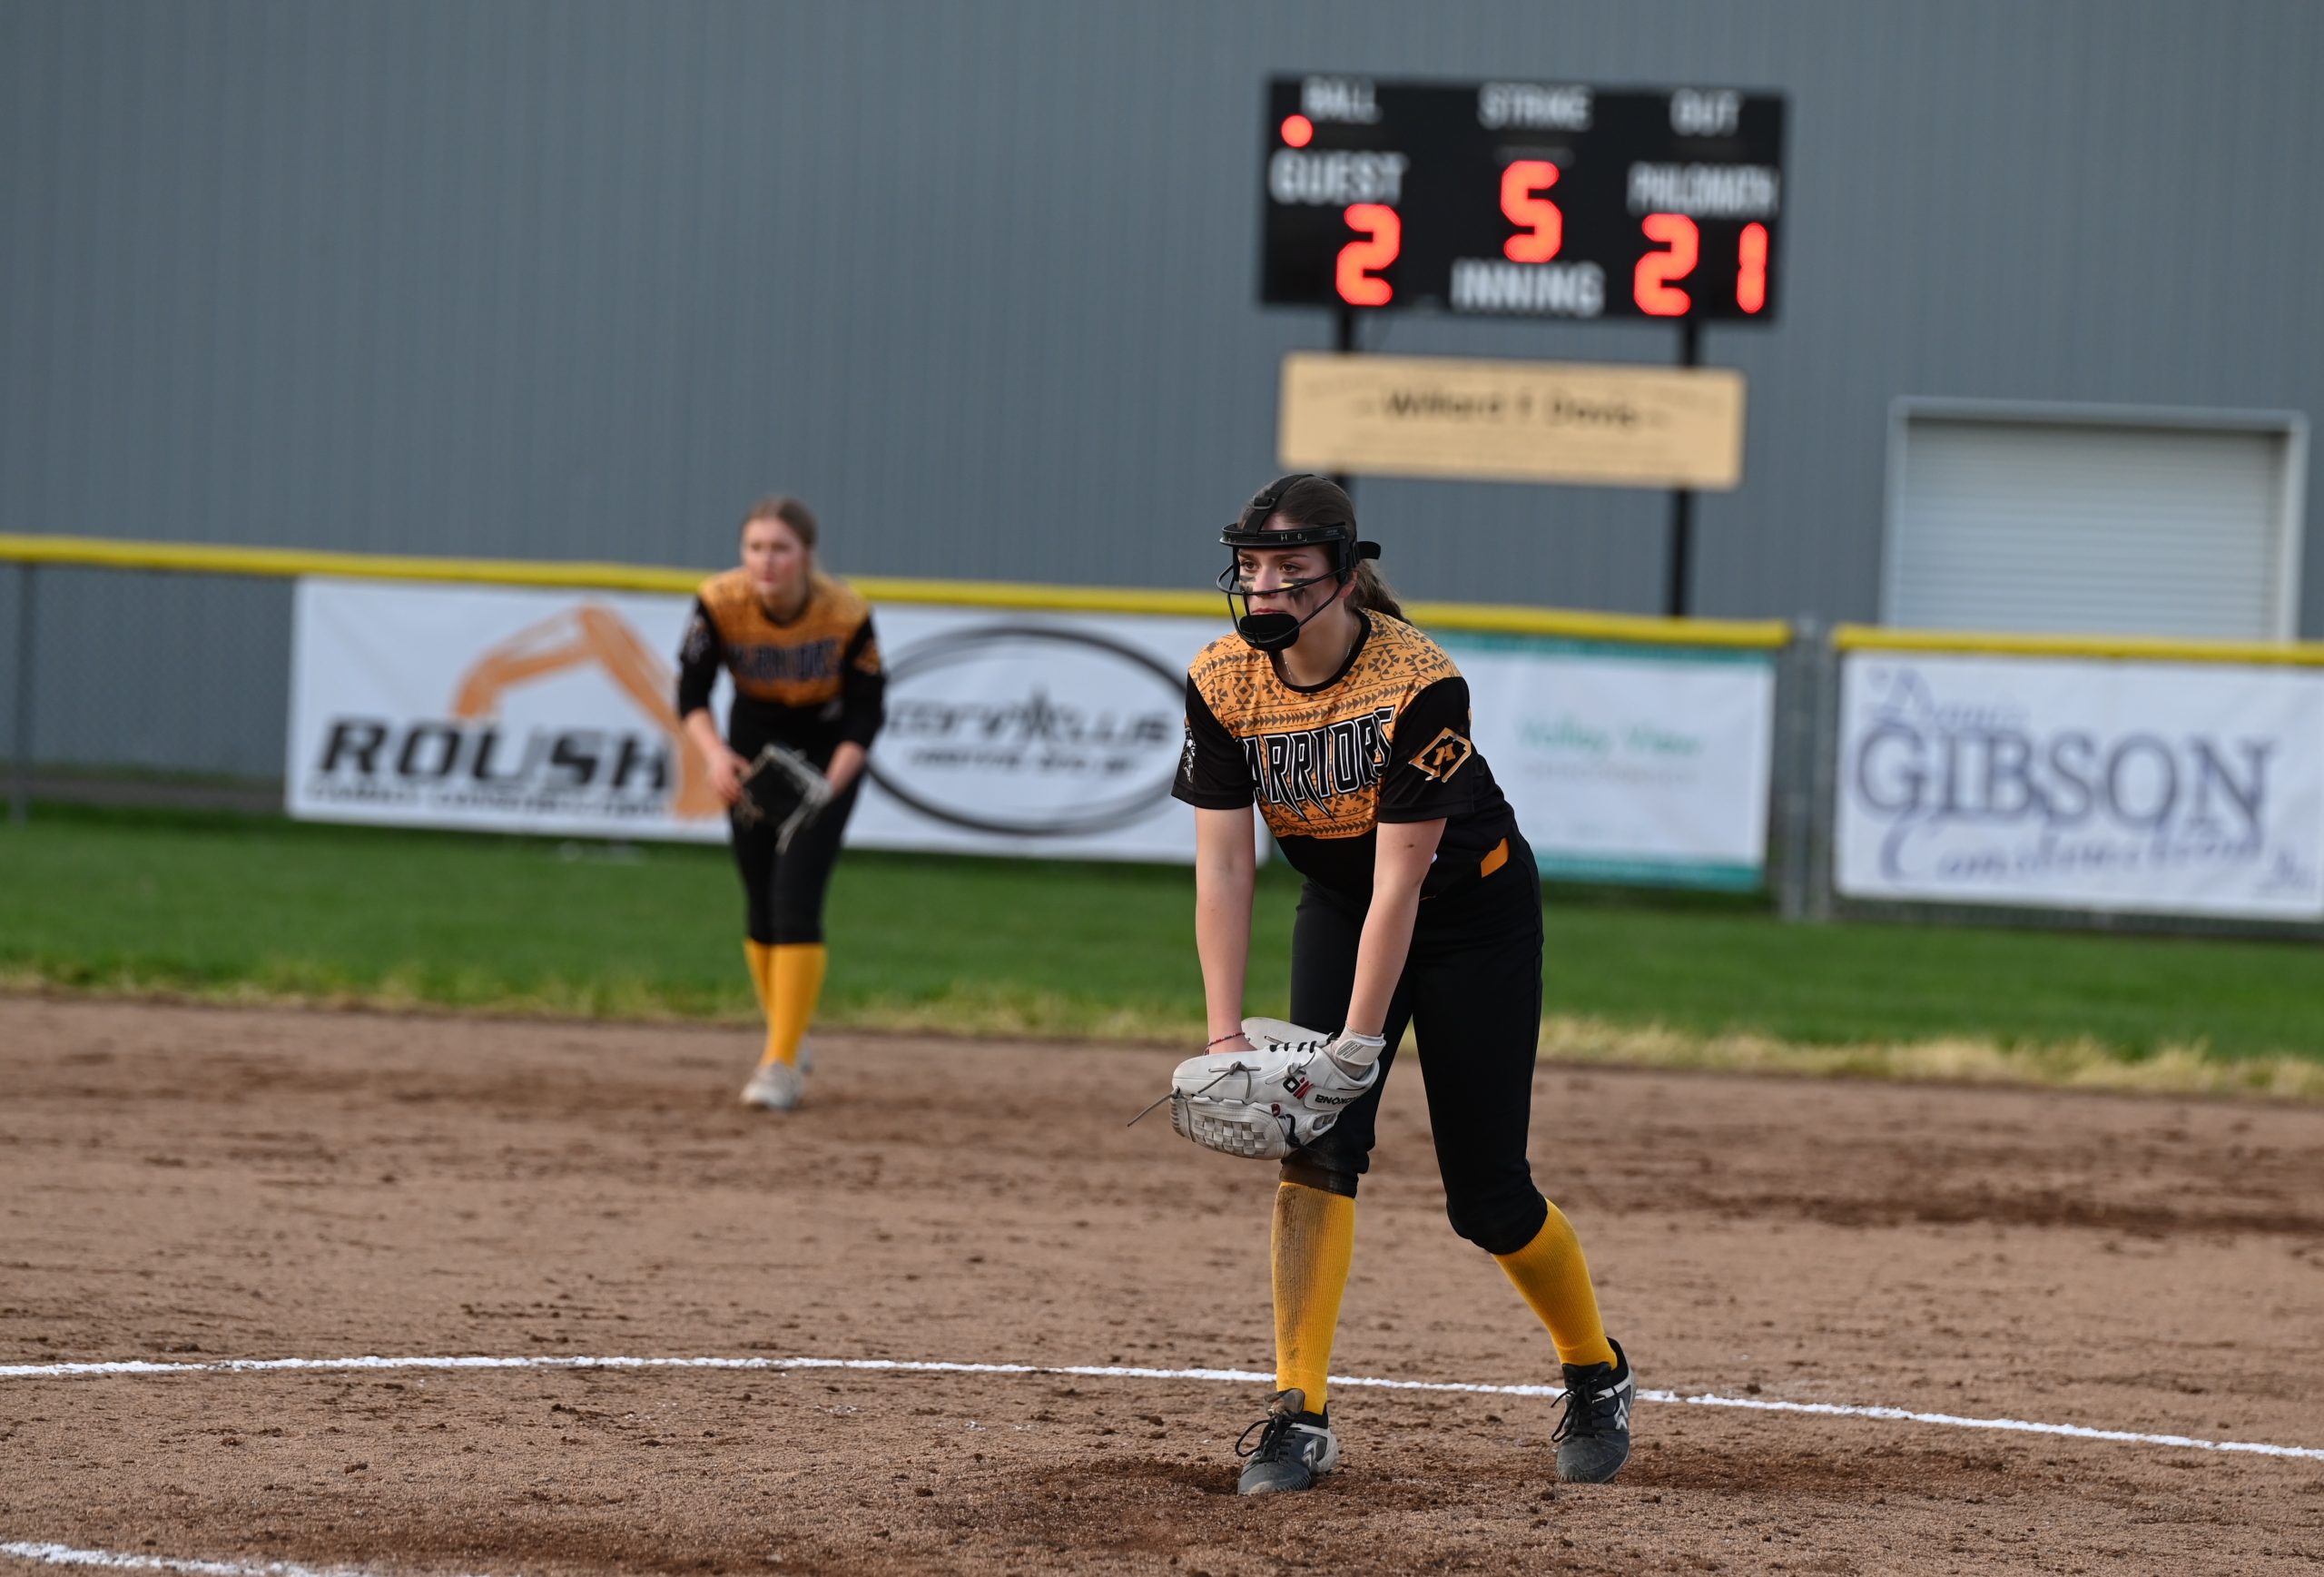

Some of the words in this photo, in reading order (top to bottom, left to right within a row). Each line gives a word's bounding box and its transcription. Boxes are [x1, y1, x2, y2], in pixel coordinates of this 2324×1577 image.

[1302, 78, 1380, 123] BALL
[1479, 84, 1591, 129] STRIKE
[1671, 90, 1738, 134] OUT
[1271, 153, 1406, 203] GUEST
[1501, 161, 1561, 262] 5
[1336, 203, 1401, 305] 2
[1634, 213, 1768, 316] 21
[1452, 261, 1604, 315] INNING
[319, 721, 675, 787] ROUSH
[1239, 705, 1395, 822] ARRIORS
[1855, 725, 2278, 835] GIBSON
